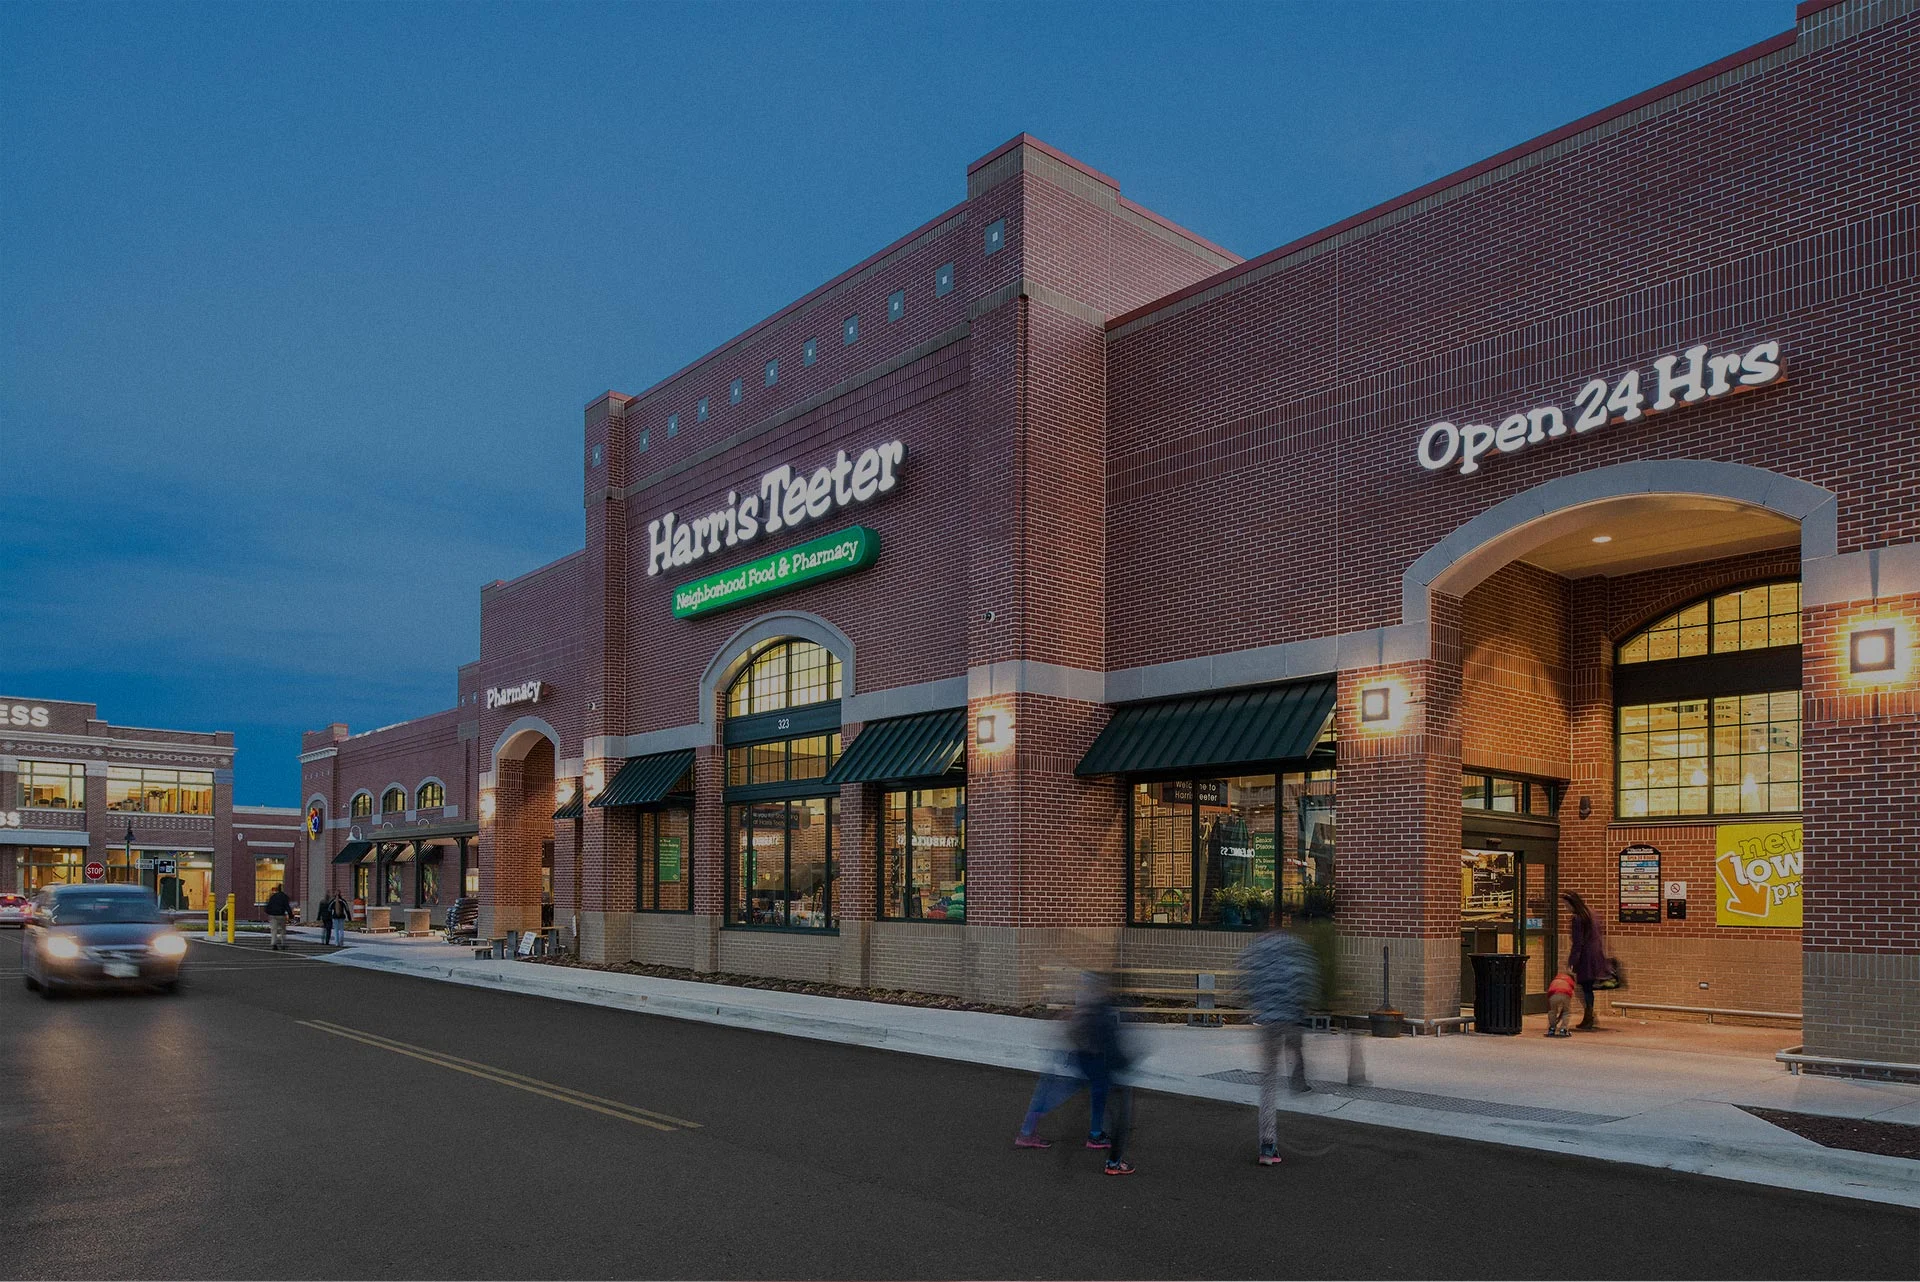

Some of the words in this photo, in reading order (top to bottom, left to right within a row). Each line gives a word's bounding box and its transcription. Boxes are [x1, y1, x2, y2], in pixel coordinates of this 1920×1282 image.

[1417, 405, 1568, 474] Open
[1574, 370, 1644, 433] 24
[1653, 340, 1780, 411] Hrs
[647, 491, 760, 576] Harris
[761, 440, 904, 534] Teeter
[676, 570, 747, 610] Neighborhood
[748, 562, 775, 587] Food
[778, 556, 791, 578] &
[792, 540, 859, 574] Pharmacy
[486, 680, 542, 710] Pharmacy
[777, 718, 790, 730] 323
[86, 867, 103, 875] STOP
[1729, 851, 1804, 886] low
